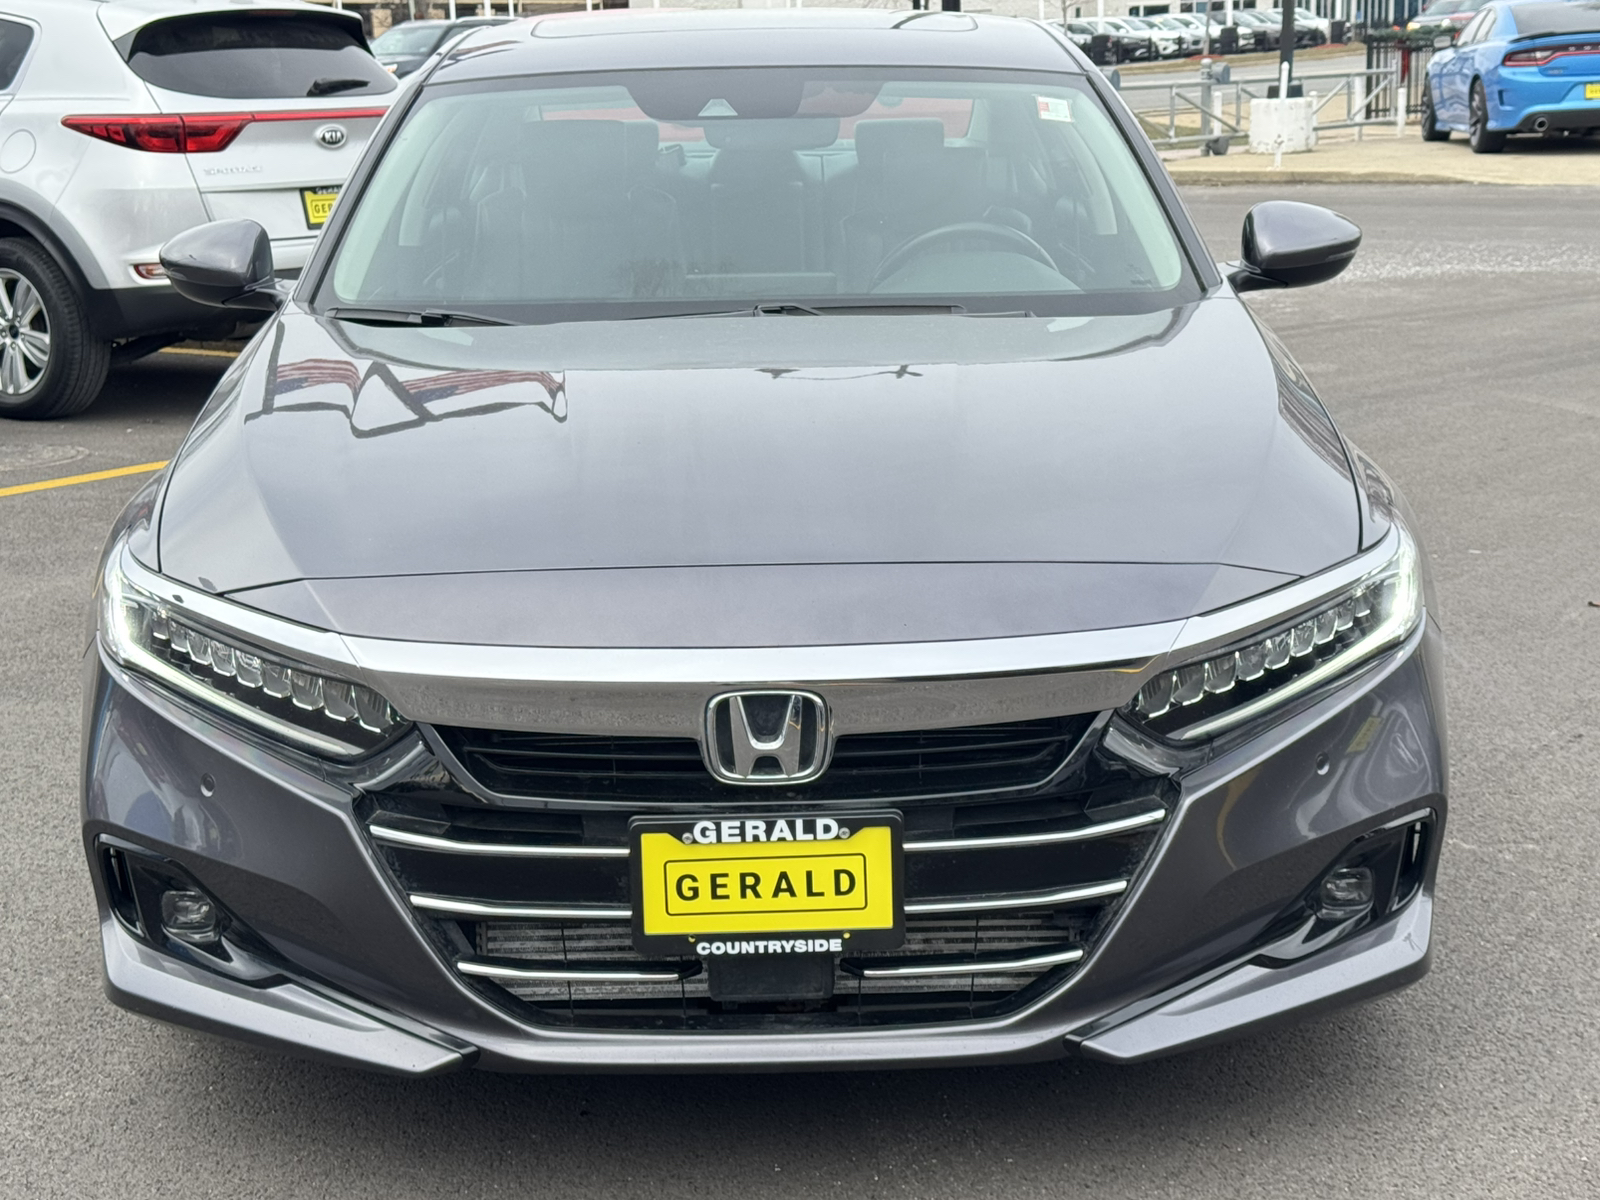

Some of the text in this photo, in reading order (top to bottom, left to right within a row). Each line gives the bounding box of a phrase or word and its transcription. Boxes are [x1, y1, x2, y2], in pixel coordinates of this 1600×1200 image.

[693, 818, 839, 844] GERALD
[676, 868, 856, 901] GERALD
[696, 938, 842, 955] COUNTRYSIDE
